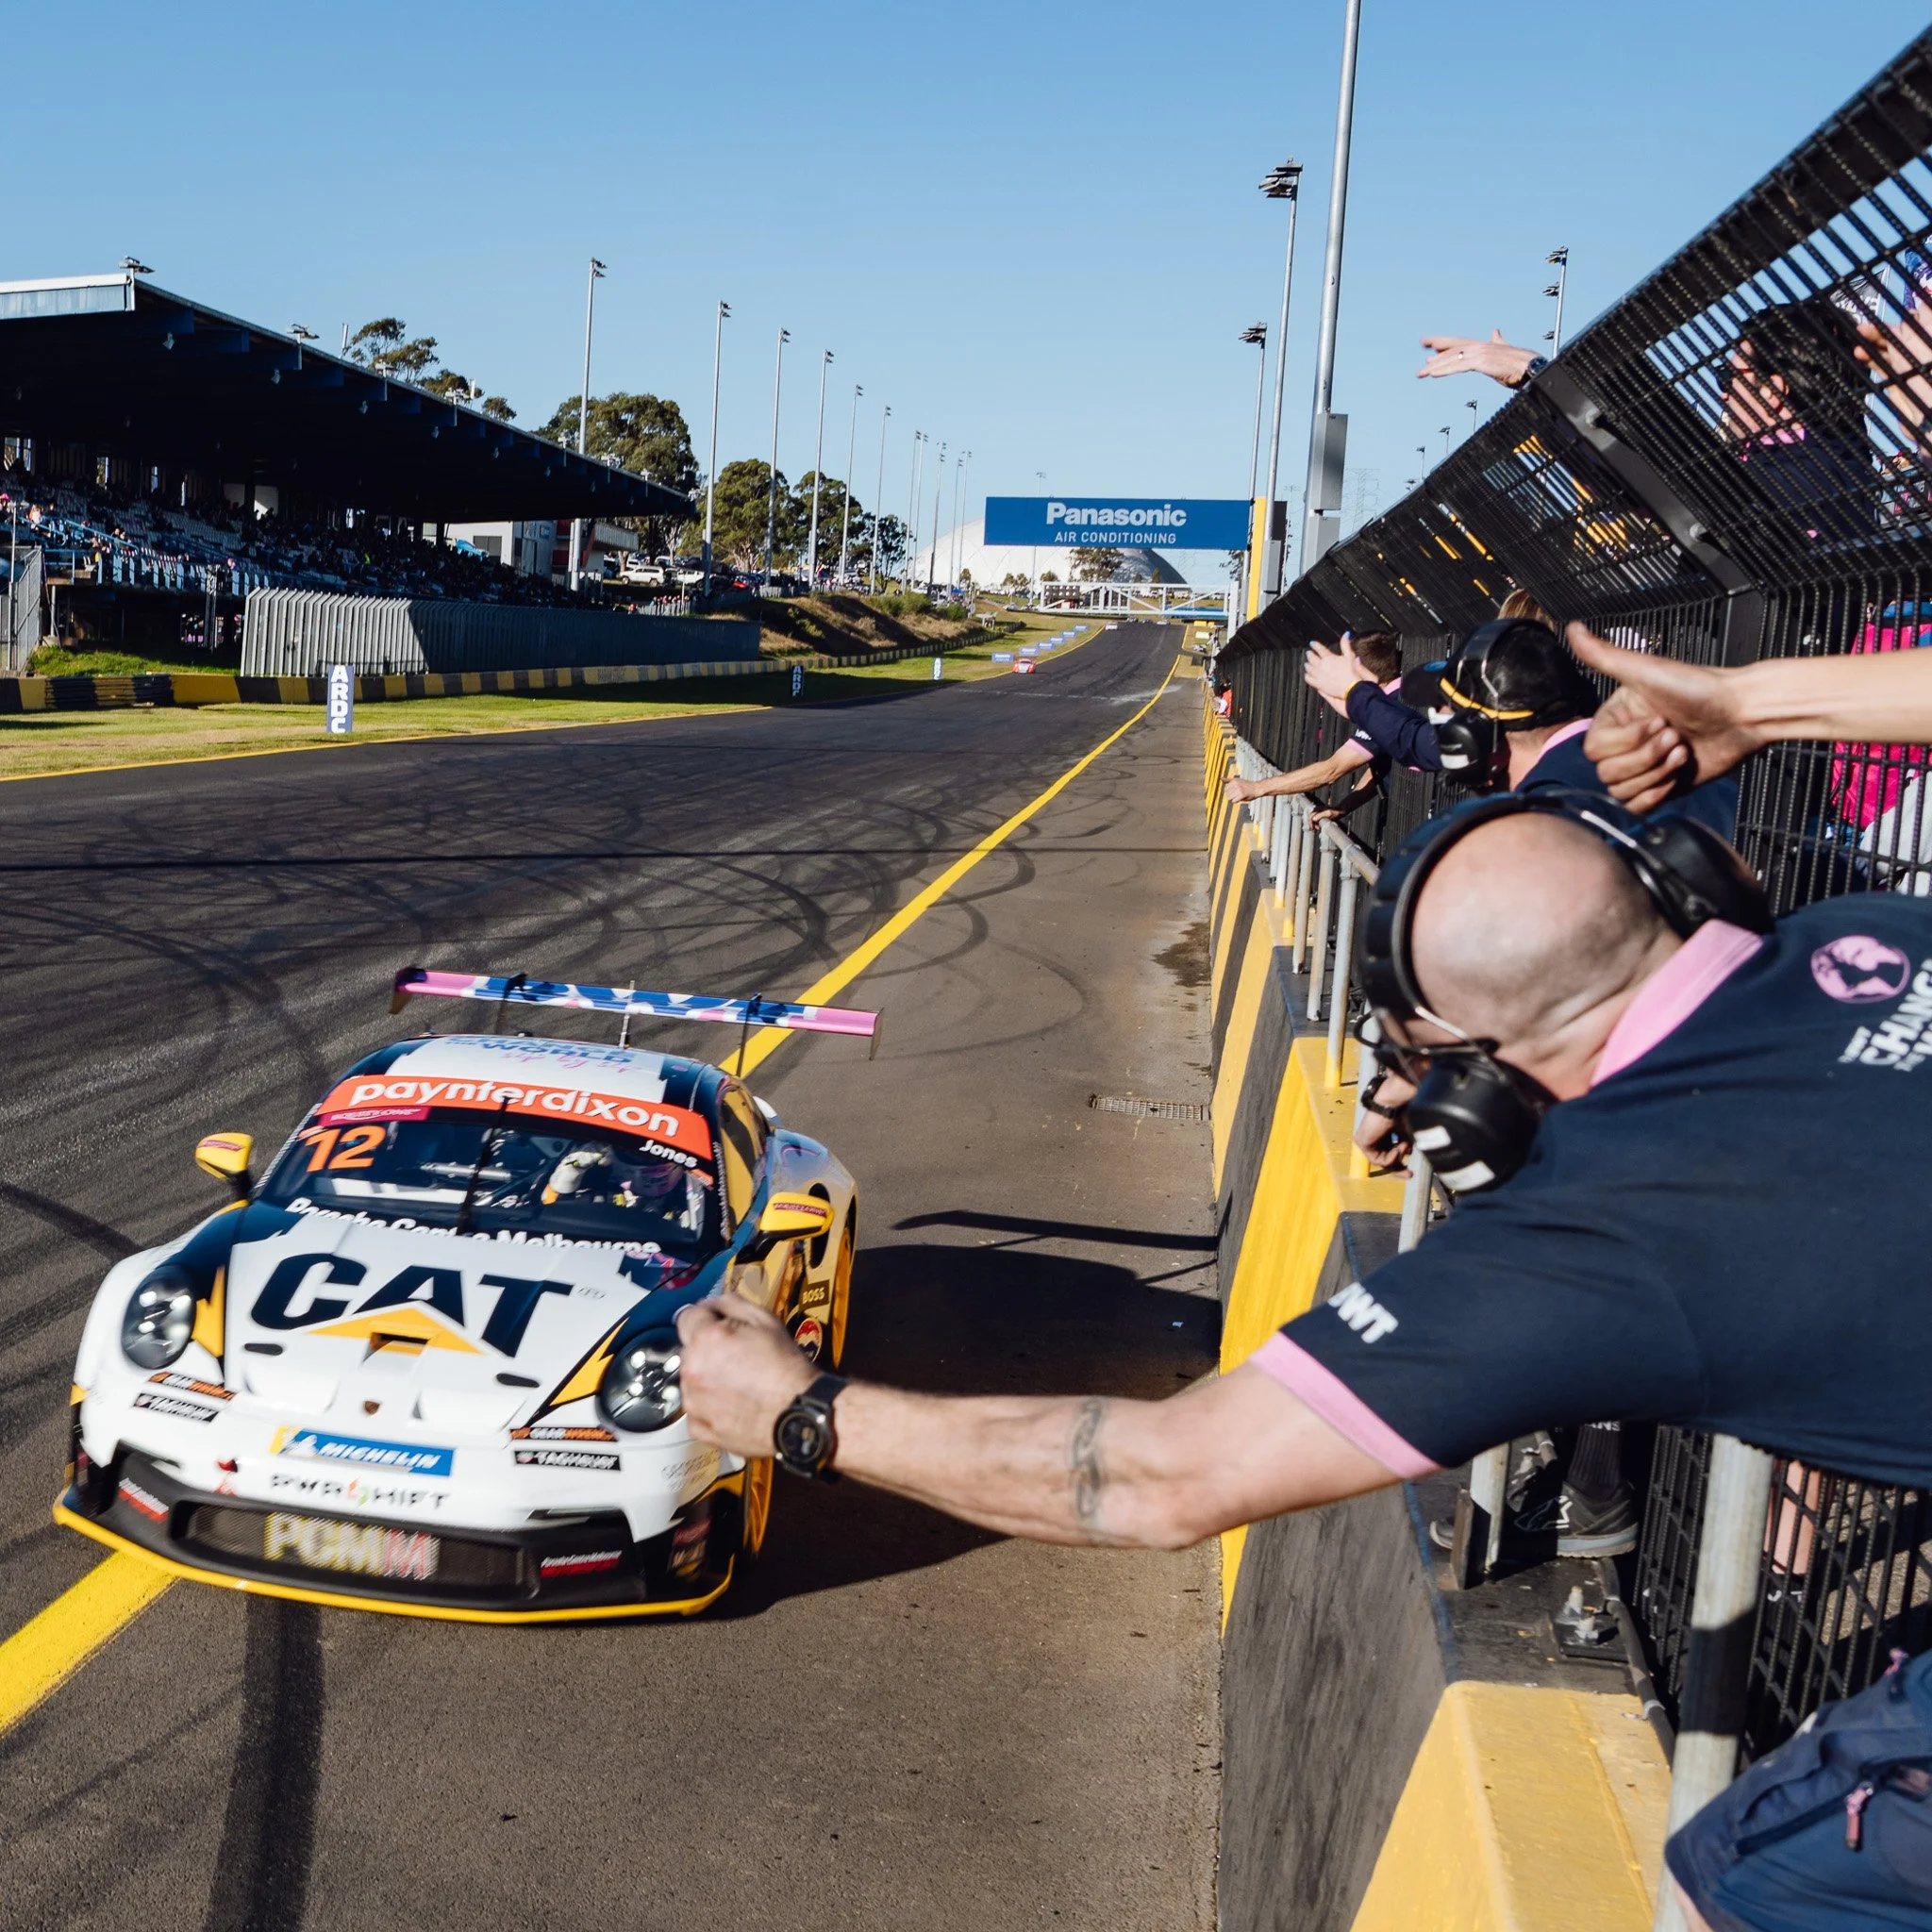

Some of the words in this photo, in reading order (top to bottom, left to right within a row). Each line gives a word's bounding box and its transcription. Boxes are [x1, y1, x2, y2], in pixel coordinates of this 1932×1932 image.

[1046, 502, 1187, 526] Panasonic
[1055, 531, 1076, 542] AIR
[1081, 532, 1176, 544] CONDITIONING
[331, 665, 348, 733] ARDC
[482, 1043, 631, 1063] WORLD
[349, 1079, 679, 1138] paynterdixon
[300, 1124, 387, 1173] 12
[639, 1139, 698, 1169] Jones
[250, 1252, 576, 1358] CAT
[802, 1286, 825, 1305] BOSS
[317, 1441, 441, 1469] MICHELIN
